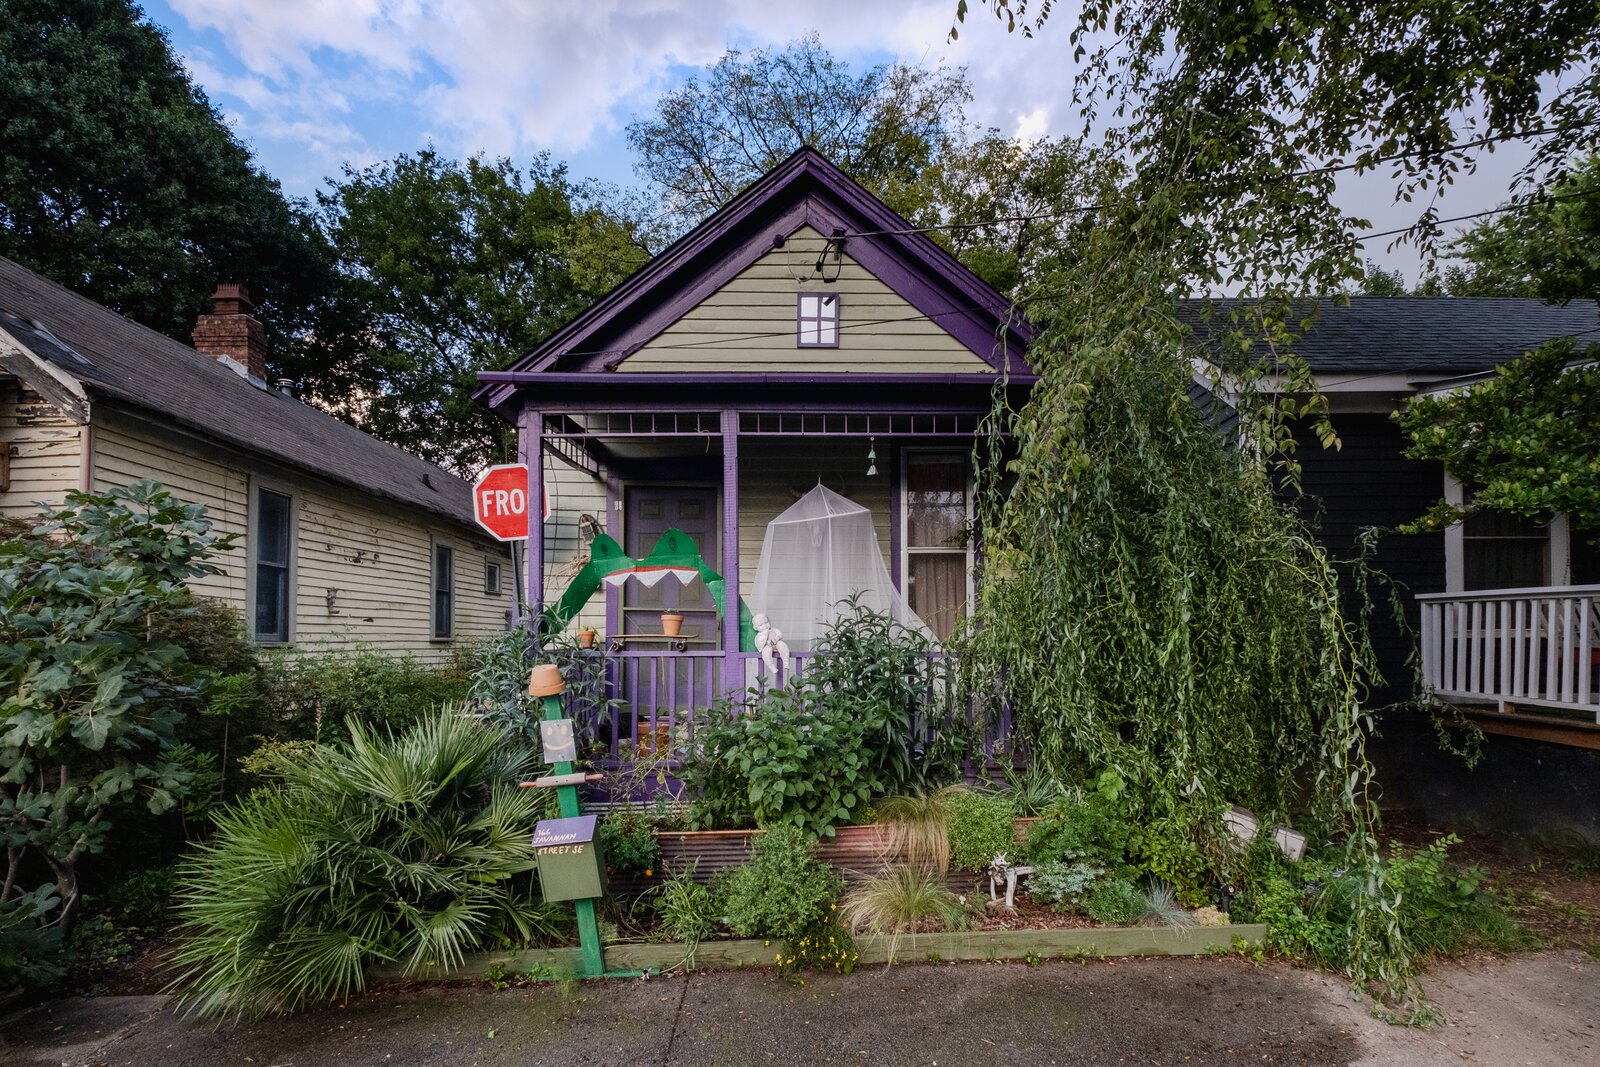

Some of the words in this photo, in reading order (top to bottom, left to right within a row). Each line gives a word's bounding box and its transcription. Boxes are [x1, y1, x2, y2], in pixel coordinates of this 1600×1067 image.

[482, 489, 527, 517] FRO
[534, 833, 576, 843] SAVANNAH
[537, 846, 570, 855] STREET
[572, 845, 584, 854] SE
